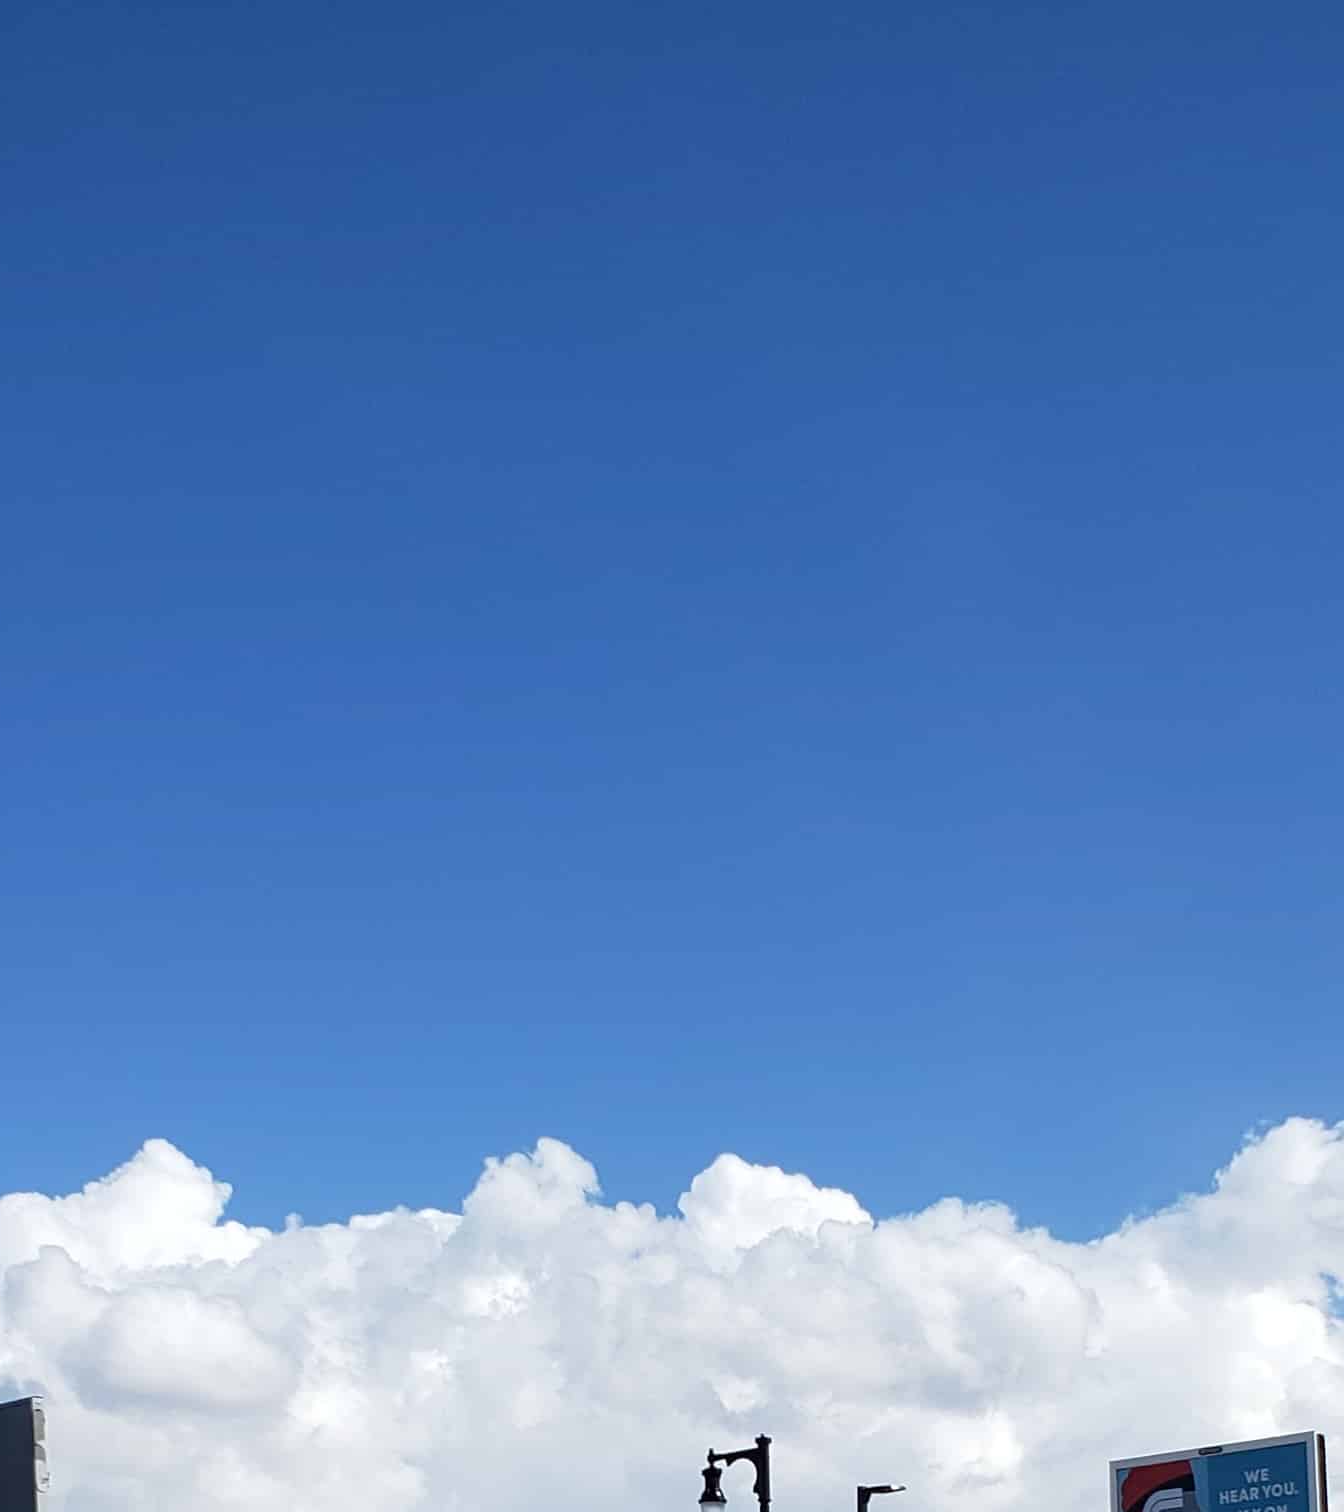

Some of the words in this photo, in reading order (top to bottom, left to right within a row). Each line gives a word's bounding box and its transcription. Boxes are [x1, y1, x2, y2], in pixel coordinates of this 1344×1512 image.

[1244, 1468, 1270, 1483] WE
[1219, 1487, 1259, 1504] HEAR
[1262, 1482, 1299, 1499] YOU.
